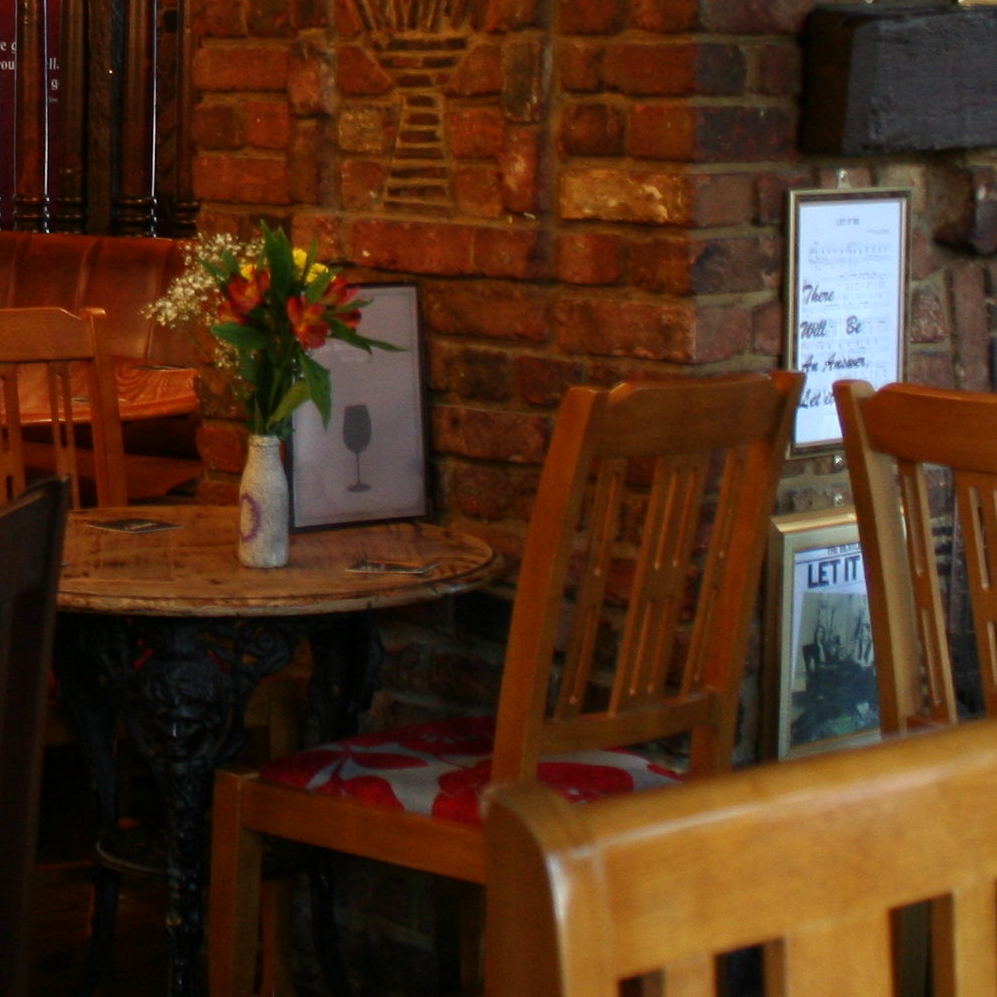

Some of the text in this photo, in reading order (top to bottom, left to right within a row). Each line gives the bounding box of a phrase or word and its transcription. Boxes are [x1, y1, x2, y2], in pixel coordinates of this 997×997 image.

[802, 283, 835, 305] There
[800, 315, 863, 340] Will Be
[801, 354, 819, 373] An
[798, 389, 821, 409] Let
[808, 555, 861, 590] LET IT
